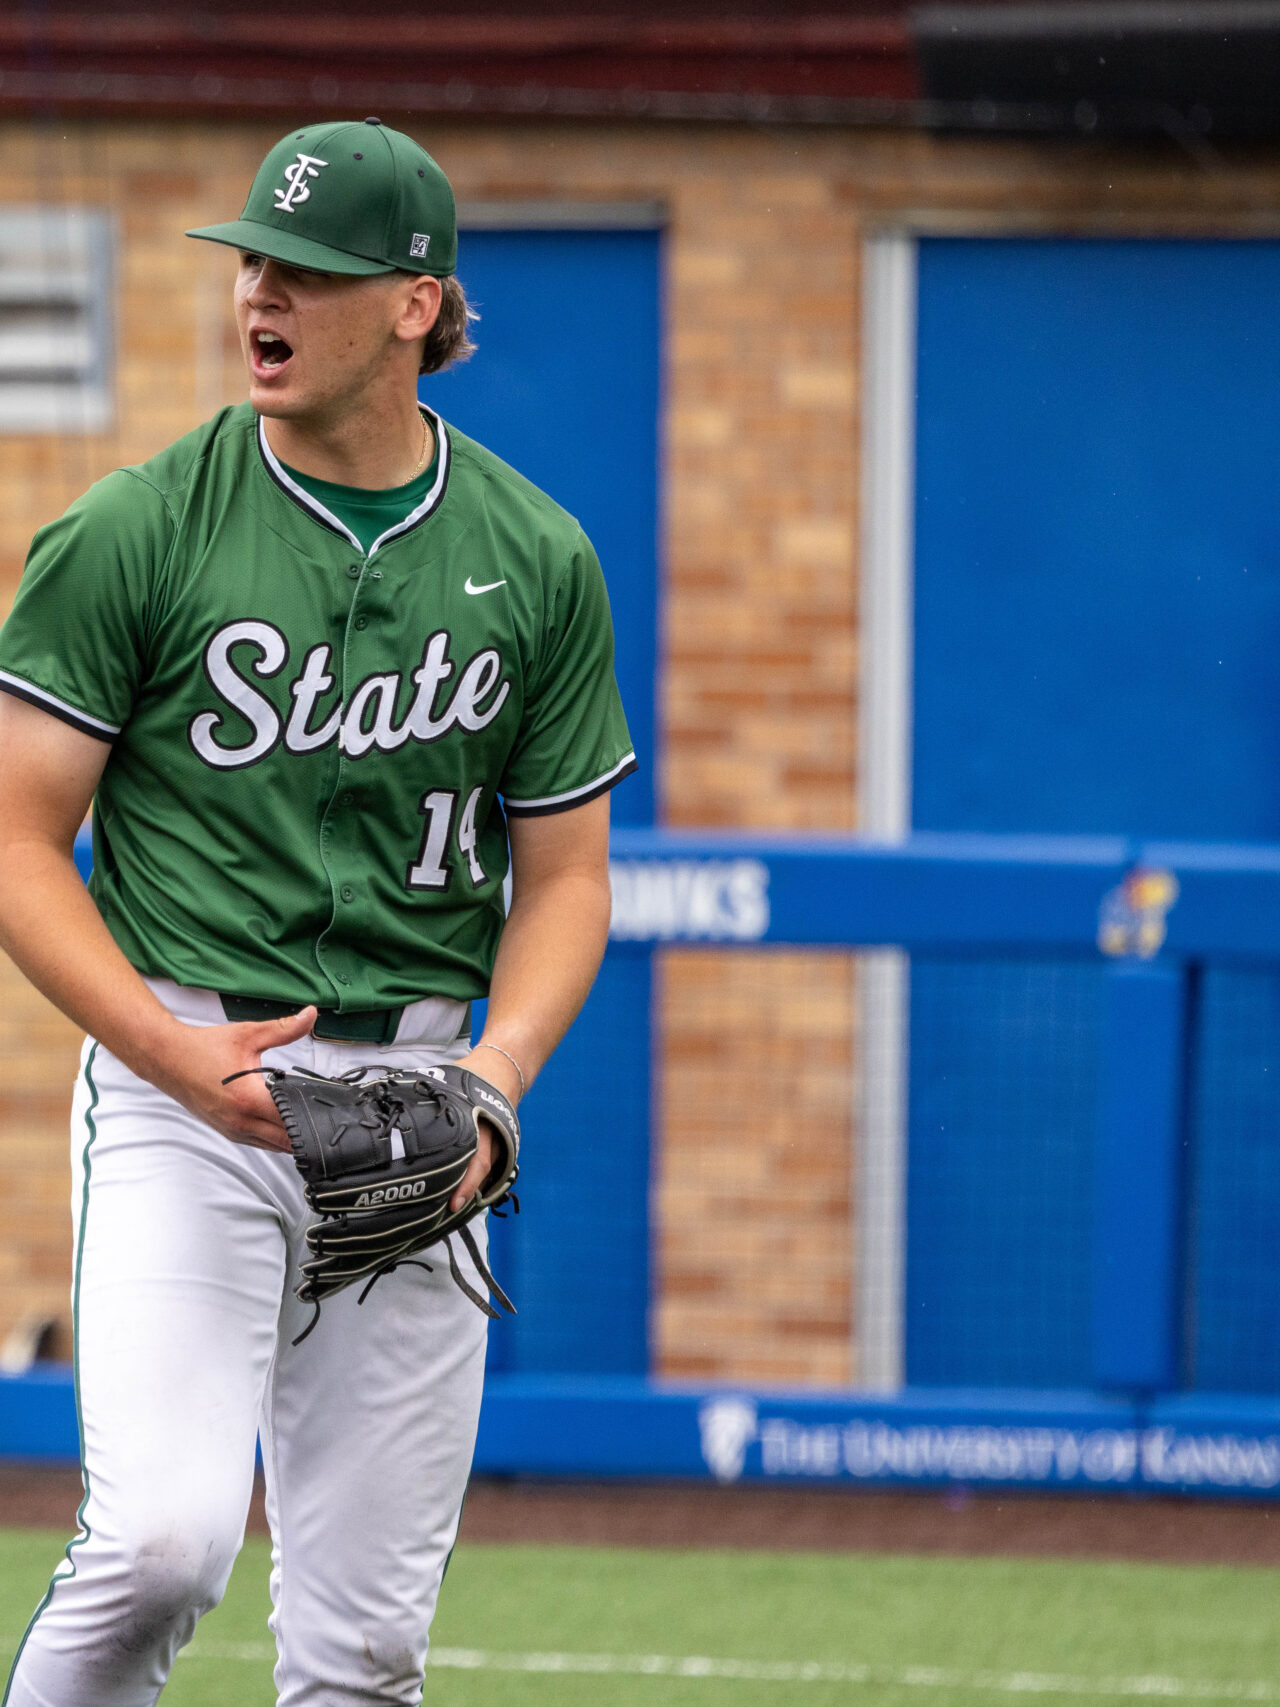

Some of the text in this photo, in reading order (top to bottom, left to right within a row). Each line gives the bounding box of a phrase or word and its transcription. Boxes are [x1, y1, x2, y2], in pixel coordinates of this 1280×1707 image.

[187, 617, 512, 771] State
[405, 786, 489, 892] 14
[354, 1180, 426, 1208] A2000
